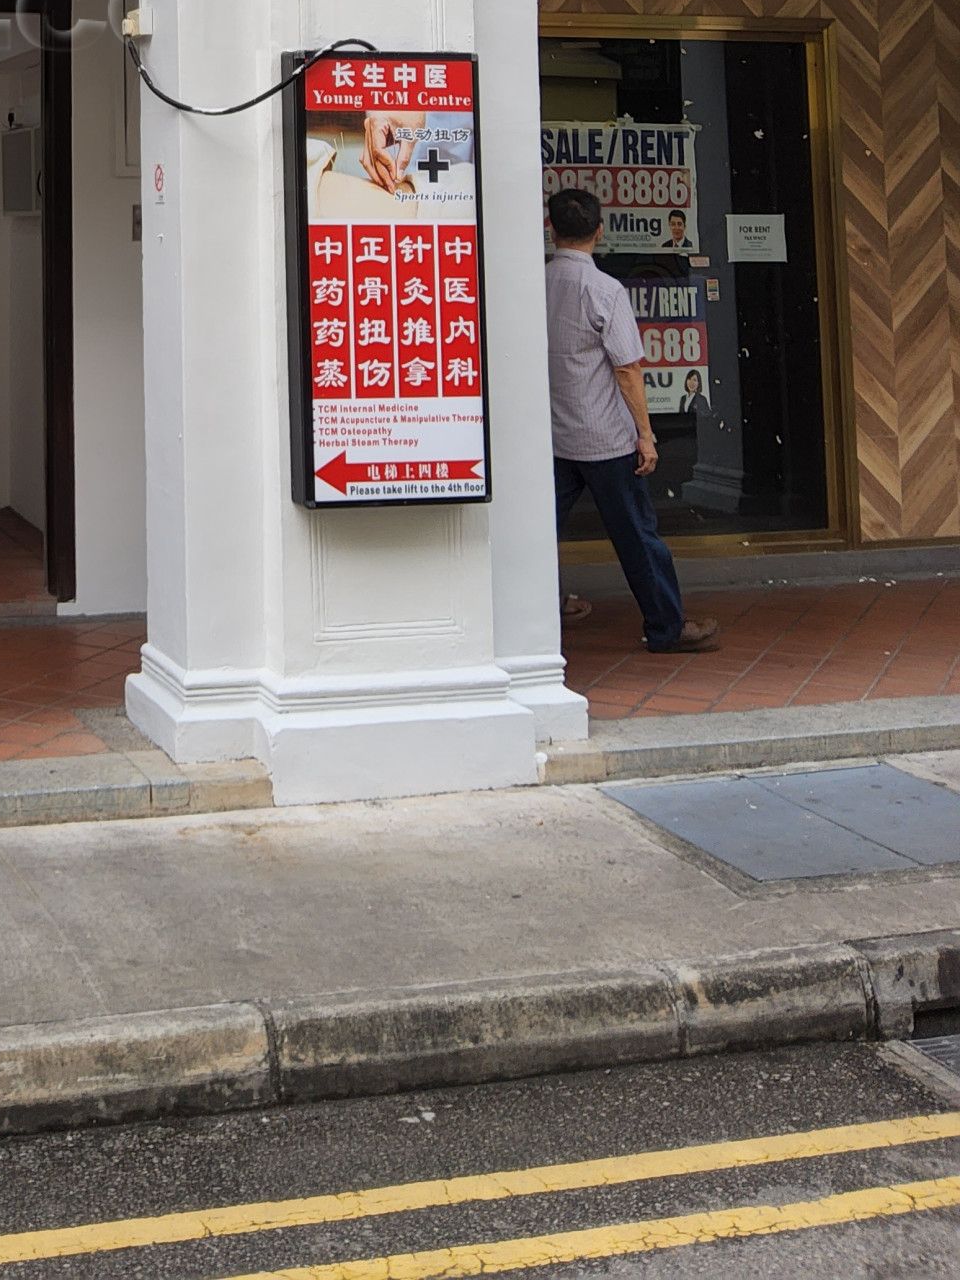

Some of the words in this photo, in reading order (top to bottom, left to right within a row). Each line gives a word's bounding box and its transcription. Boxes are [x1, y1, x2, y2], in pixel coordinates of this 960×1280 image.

[332, 62, 448, 89] 长生中医
[313, 90, 363, 108] Young
[370, 91, 409, 106] TCM
[417, 91, 472, 106] Centre
[395, 128, 471, 142] 运动扭伤
[541, 129, 689, 165] SALE/RENT
[394, 191, 429, 202] Sports
[432, 191, 474, 203] injuries
[616, 169, 688, 205] 8886
[609, 213, 662, 237] Ming
[312, 236, 348, 388] 中药药蒸
[355, 236, 392, 387] 正骨扭伤
[398, 235, 435, 387] 针灸推拿
[443, 236, 478, 386] 中医内科
[628, 286, 697, 318] LE/RENT
[318, 405, 337, 413] TCM
[378, 404, 419, 412] Medicine
[340, 416, 390, 425] Acupuncture
[400, 415, 450, 424] Manipulative
[452, 414, 484, 424] Therapy
[319, 428, 337, 436] TCM
[340, 427, 392, 437] Osteopathy
[319, 439, 349, 447] Herbal
[351, 439, 380, 447] Steam
[382, 438, 419, 448] Therapy
[367, 463, 449, 481] 电梯上四楼
[350, 485, 381, 495] Please
[382, 485, 403, 495] take
[404, 484, 418, 494] lift
[420, 484, 429, 493] to
[430, 483, 446, 493] the
[448, 483, 462, 492] 4th
[464, 482, 484, 492] floor
